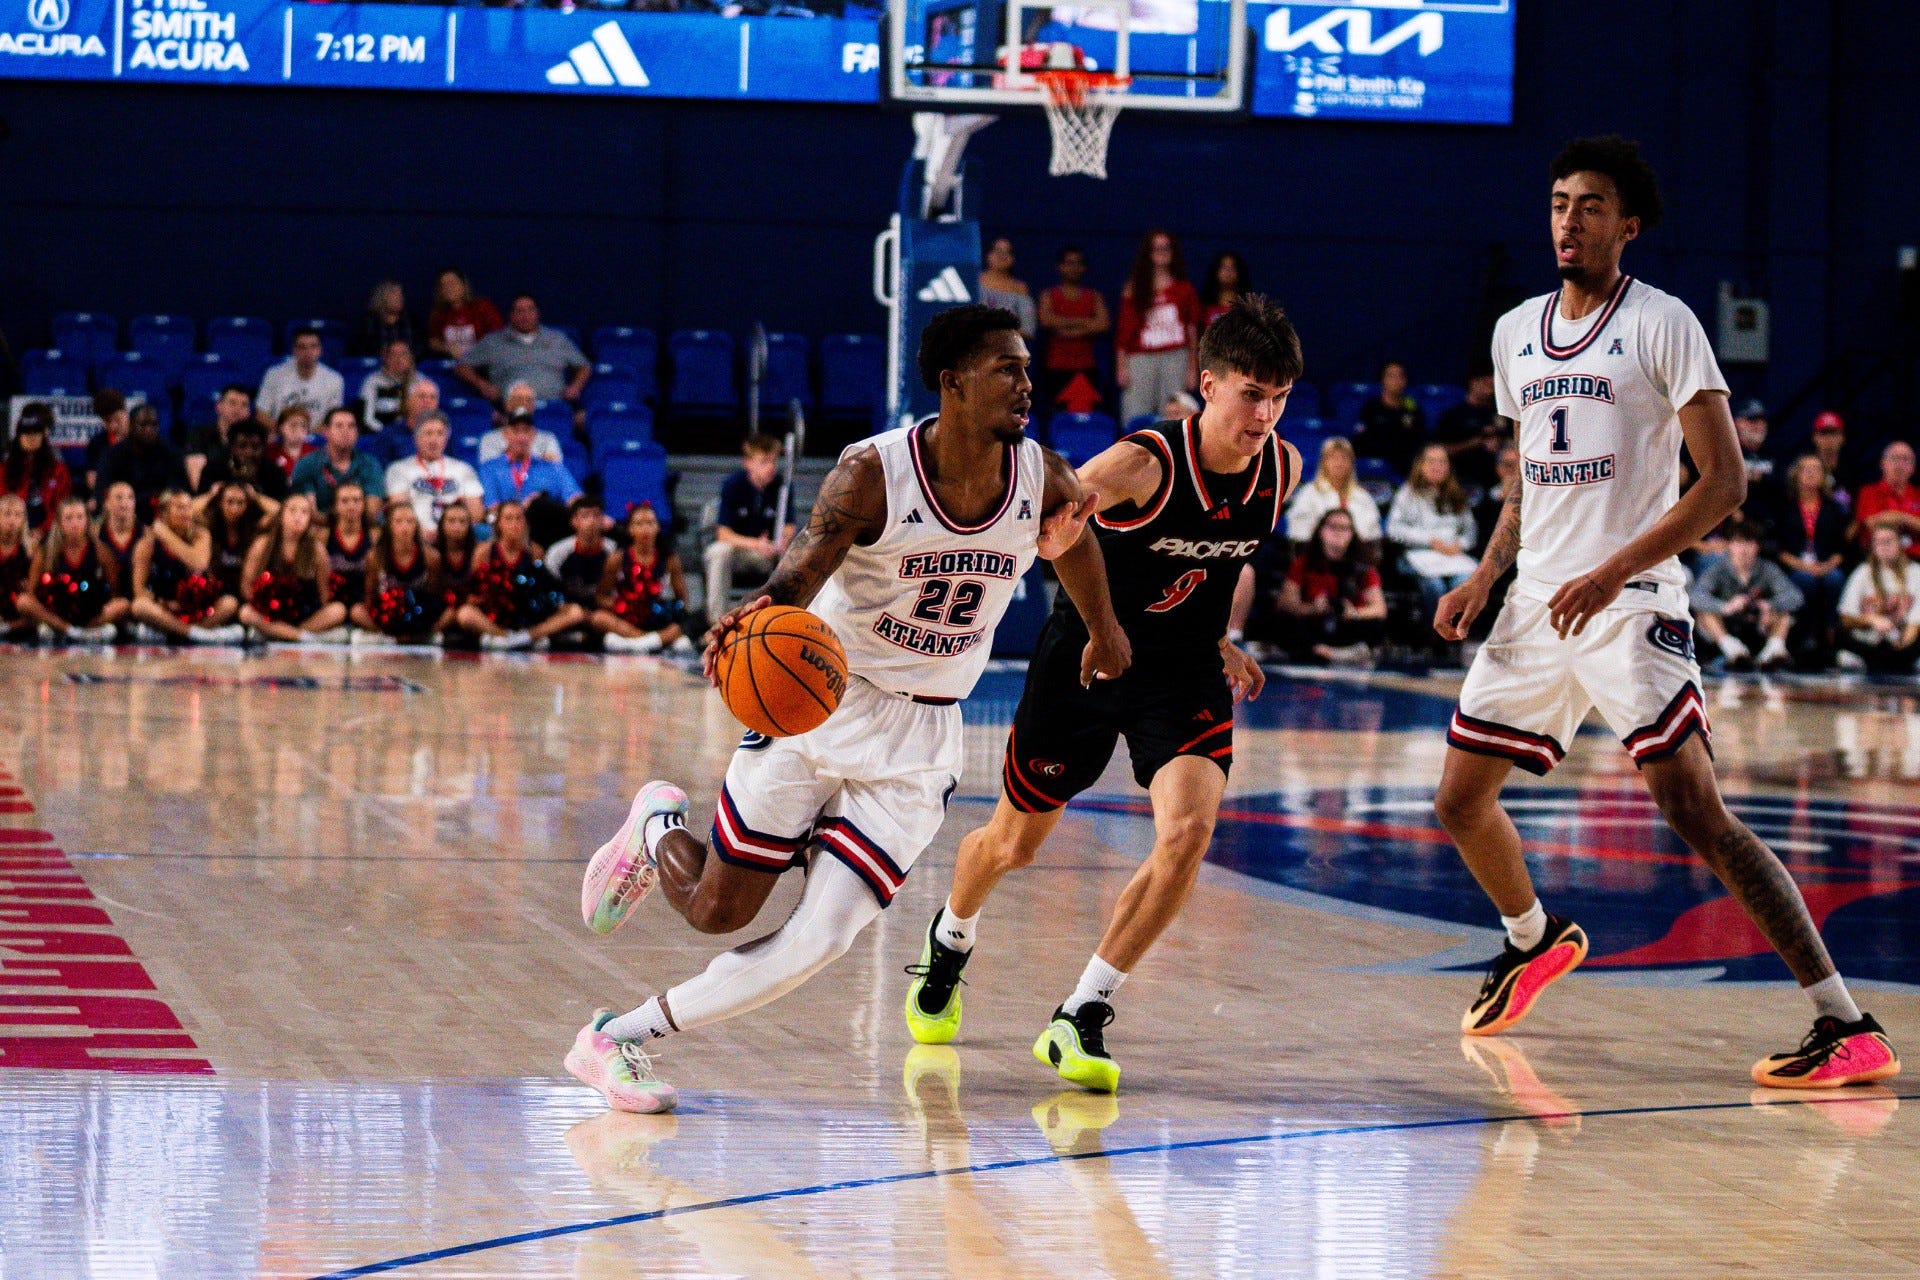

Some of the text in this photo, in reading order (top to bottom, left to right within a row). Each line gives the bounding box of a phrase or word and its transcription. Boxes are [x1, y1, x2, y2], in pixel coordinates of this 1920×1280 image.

[131, 10, 236, 39] SMITH
[0, 32, 106, 56] ACURA
[130, 40, 250, 71] ACURA
[315, 32, 426, 63] 7:12 PM
[1521, 374, 1615, 411] FLORIDA
[1549, 406, 1571, 454] 1
[1525, 454, 1615, 486] ATLANTIC
[1149, 537, 1259, 560] PACIFIC
[899, 550, 1016, 579] FLORIDA
[910, 578, 986, 627] 22
[1144, 568, 1208, 613] 9
